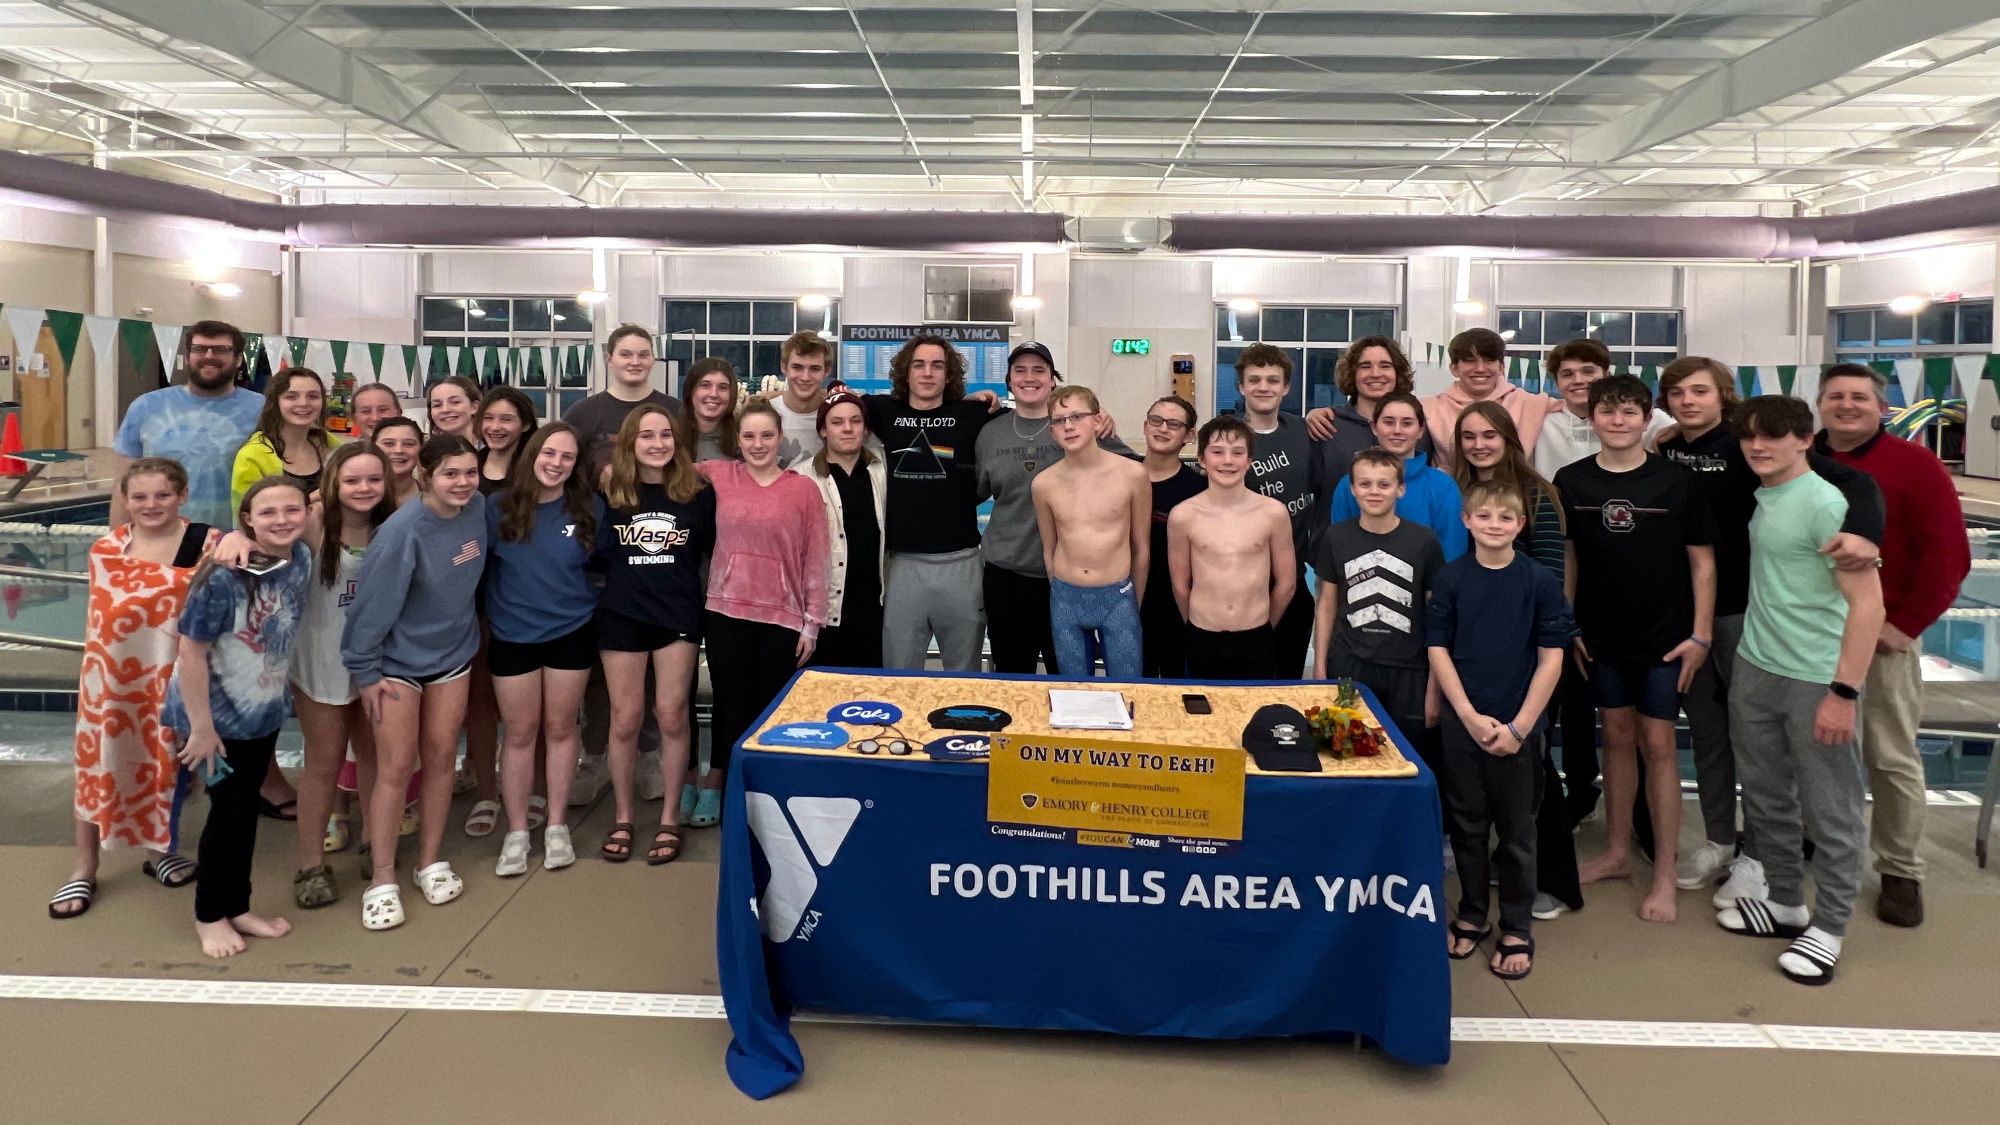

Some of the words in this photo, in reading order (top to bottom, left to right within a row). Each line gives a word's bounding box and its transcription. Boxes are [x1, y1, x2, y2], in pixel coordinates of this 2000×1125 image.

[850, 327, 921, 339] FOOTHILLS
[962, 328, 1001, 340] YMCA
[894, 417, 918, 427] PINK
[920, 417, 956, 427] FLOYD
[1251, 450, 1290, 476] Build
[1259, 480, 1285, 496] the
[613, 525, 690, 550] Wasps
[628, 555, 675, 565] SWIMMING
[841, 705, 891, 721] Cats
[1019, 745, 1049, 762] ON
[1053, 749, 1084, 765] MY
[1090, 751, 1132, 768] WAY
[1137, 753, 1163, 770] TO
[1168, 755, 1215, 773] E&H!
[1042, 797, 1088, 811] EMORY
[1090, 801, 1100, 812] &
[1101, 802, 1148, 816] HENRY
[1151, 806, 1210, 820] COLLEGE
[991, 825, 1066, 840] Congratulations!
[1079, 833, 1124, 844] #YOUCAN
[1135, 837, 1161, 848] MORE
[1167, 836, 1185, 844] Share
[1186, 837, 1196, 845] the
[1197, 838, 1211, 847] good
[930, 863, 1166, 905] FOOTHILLS
[1180, 874, 1301, 910] AREA
[1315, 874, 1437, 923] YMCA
[796, 909, 823, 942] YMCA
